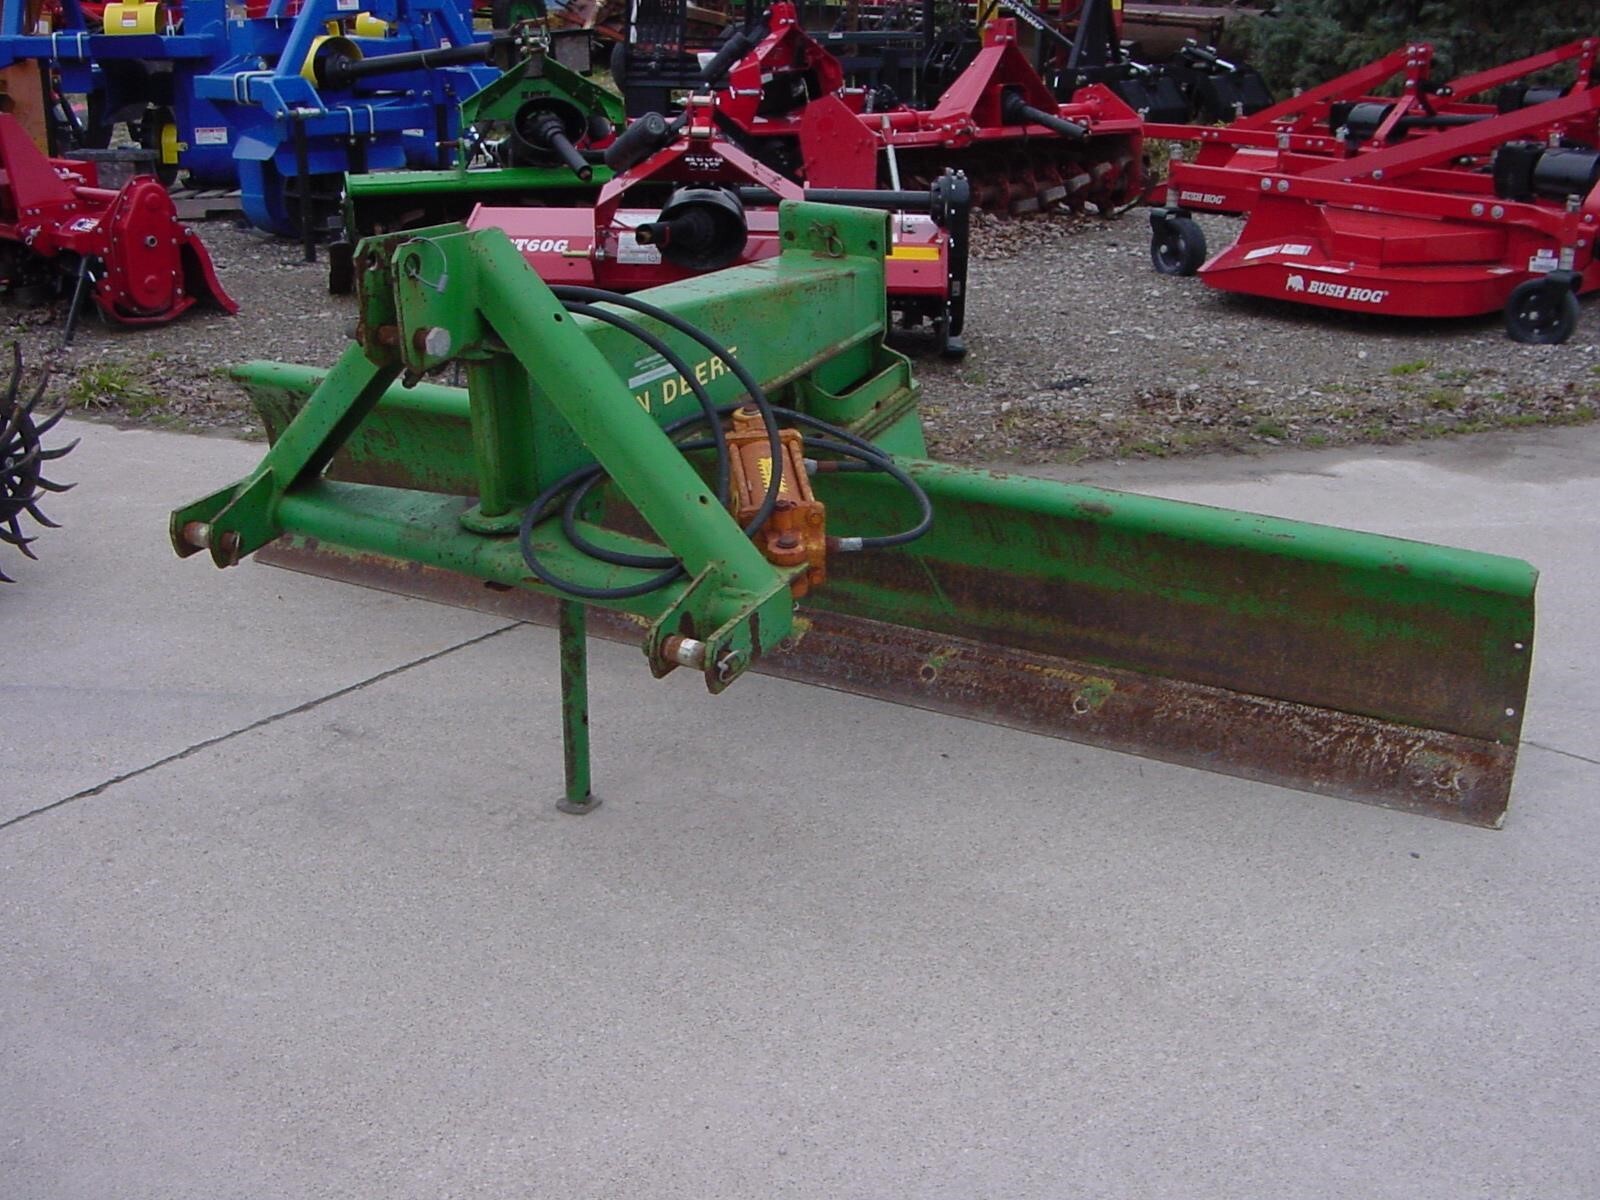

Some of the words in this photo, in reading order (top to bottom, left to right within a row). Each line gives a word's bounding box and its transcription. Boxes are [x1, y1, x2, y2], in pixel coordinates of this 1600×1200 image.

[1203, 194, 1222, 204] HOG
[509, 238, 569, 252] T60G
[1307, 280, 1348, 298] BUSH
[1347, 287, 1384, 303] HOG
